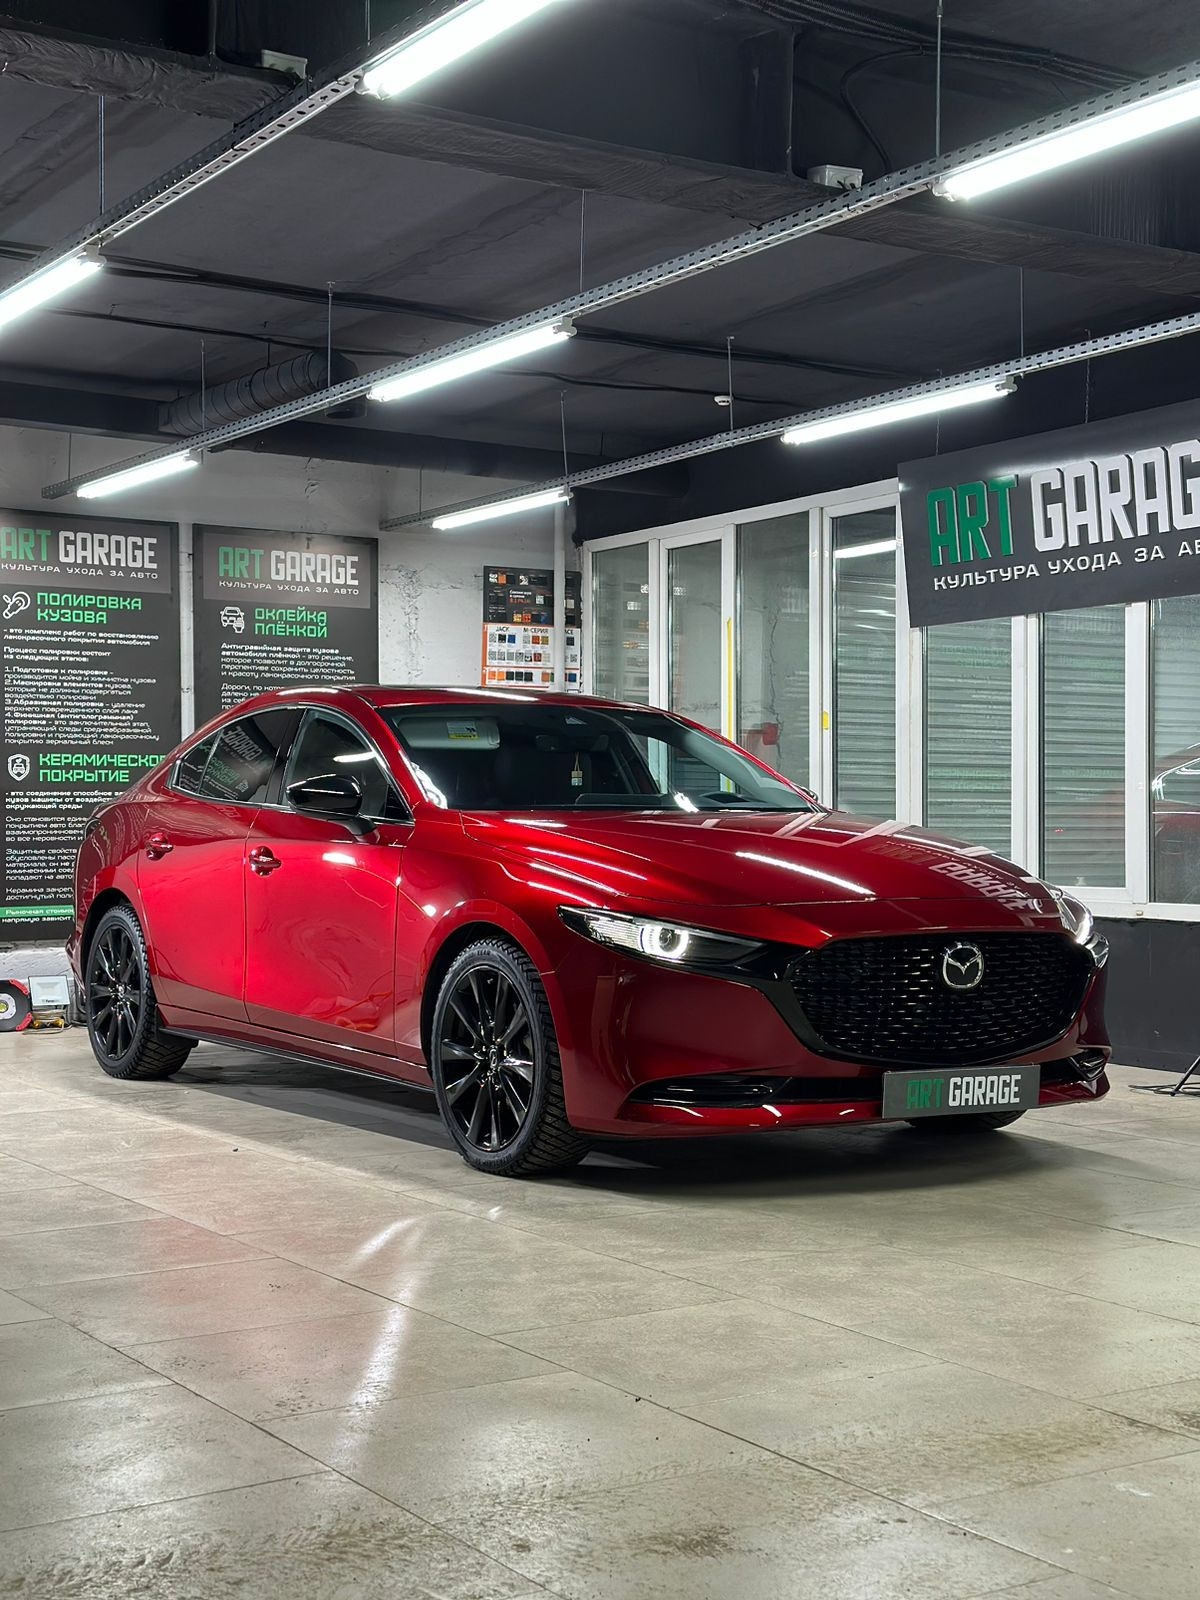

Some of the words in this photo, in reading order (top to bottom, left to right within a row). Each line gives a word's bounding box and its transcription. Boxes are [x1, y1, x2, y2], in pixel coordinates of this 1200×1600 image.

[926, 473, 1018, 567] ART
[1, 526, 51, 561] ART
[58, 530, 157, 569] GARAGE
[1, 563, 60, 573] КУЛЬТУРА
[66, 566, 104, 577] УХОДА
[130, 572, 158, 580] АВТО
[218, 546, 264, 580] ART
[270, 550, 359, 586] GARAGE
[933, 563, 1040, 591] КУЛЬТУРА
[1048, 551, 1122, 575] УХОДА
[1134, 545, 1166, 562] ЗА
[219, 580, 272, 590] КУЛЬТУРА
[277, 584, 311, 593] УХОДА
[316, 586, 329, 594] ЗА
[36, 592, 142, 610] ПОЛИРОВКА
[37, 609, 107, 624] КУЗОВА
[254, 606, 327, 622] ОКЛЕЙКА
[254, 620, 328, 638] ПЛЁНКОЙ
[4, 646, 37, 654] Процесс
[221, 642, 281, 651] Антигравийная
[39, 770, 129, 782] ПОКРЫТИЕ
[906, 1079, 944, 1109] ART
[948, 1074, 1021, 1107] GARAGE
